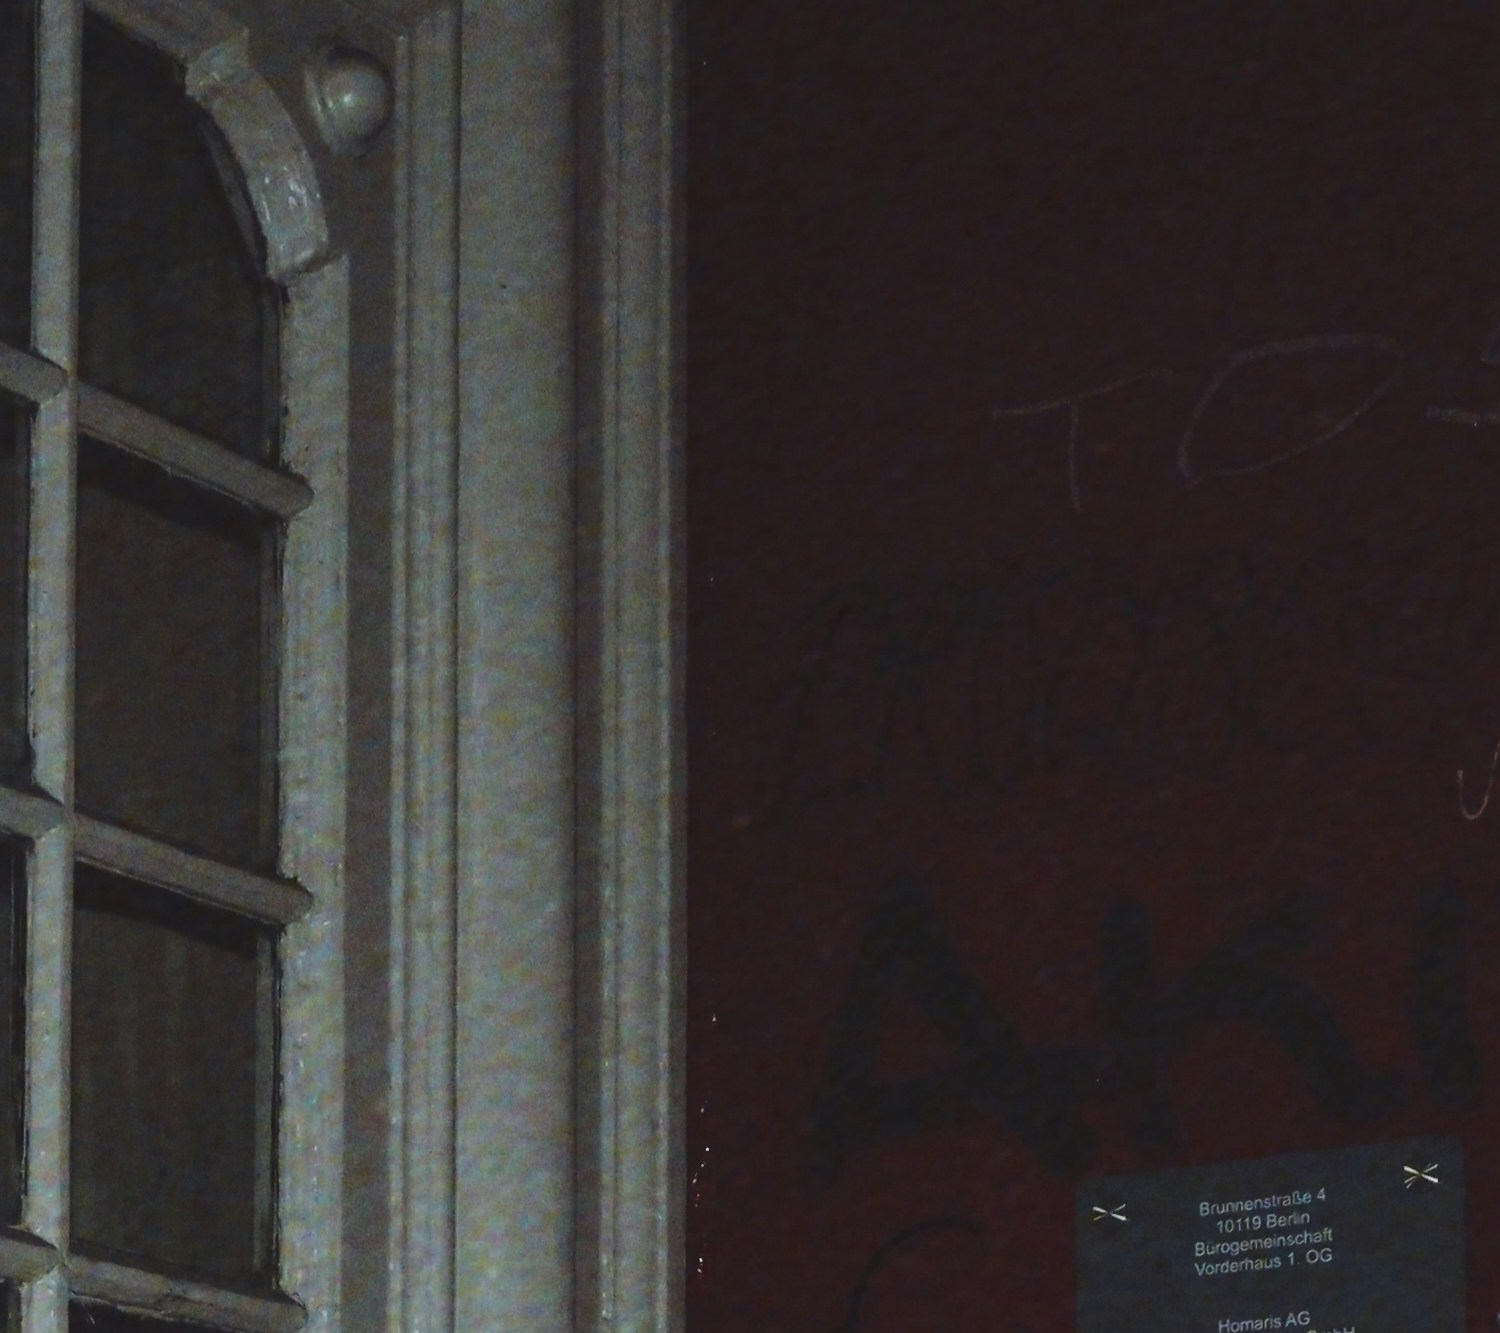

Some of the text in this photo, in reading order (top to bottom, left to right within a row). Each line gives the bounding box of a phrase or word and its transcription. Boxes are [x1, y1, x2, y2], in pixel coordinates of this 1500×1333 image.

[1200, 1187, 1326, 1217] Brunnenstraße 4
[1216, 1212, 1310, 1234] 10119 Berlin
[1195, 1227, 1333, 1257] Bürogemeinschaft
[1194, 1256, 1282, 1277] Vorderhaus
[1306, 1248, 1333, 1264] OG
[1218, 1311, 1311, 1333] Homaris AG
